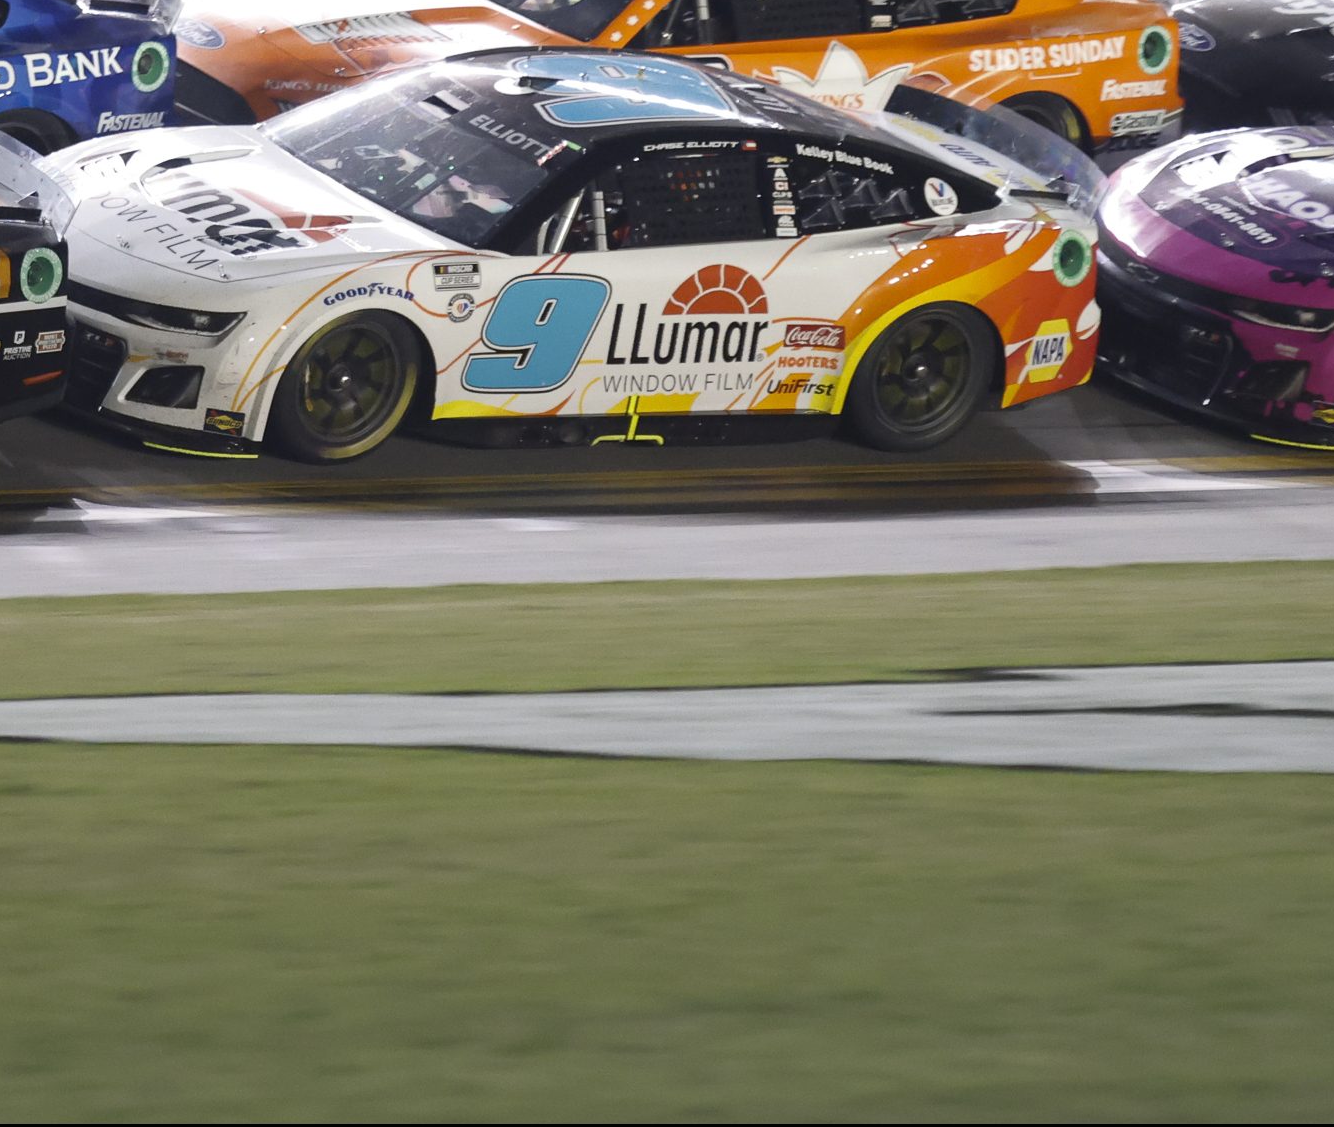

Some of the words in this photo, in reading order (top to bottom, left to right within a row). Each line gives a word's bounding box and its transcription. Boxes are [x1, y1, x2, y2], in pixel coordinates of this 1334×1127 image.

[23, 46, 123, 88] BANK
[969, 45, 1046, 73] SLIDER
[1048, 36, 1127, 68] SUNDAY
[507, 53, 740, 128] 9
[96, 110, 165, 133] FASTENAL
[468, 113, 555, 160] ELLIOTT
[643, 143, 685, 152] CHASE
[686, 140, 740, 150] ELLIOTT
[795, 143, 835, 164] Kelley
[835, 149, 863, 167] Blue
[863, 155, 895, 176] Book
[143, 222, 221, 271] FILM
[323, 282, 415, 306] GOODYEAR
[440, 275, 455, 285] CUP
[454, 275, 475, 285] SERIES
[460, 272, 614, 394] 9
[605, 302, 769, 365] LLumar
[3, 345, 33, 355] PRISTINE
[3, 352, 32, 361] AUCTION
[777, 355, 839, 371] HOOTERS
[1031, 335, 1065, 367] NAPA
[602, 373, 698, 394] WINDOW
[703, 372, 754, 392] FILM
[767, 378, 836, 397] UniFirst
